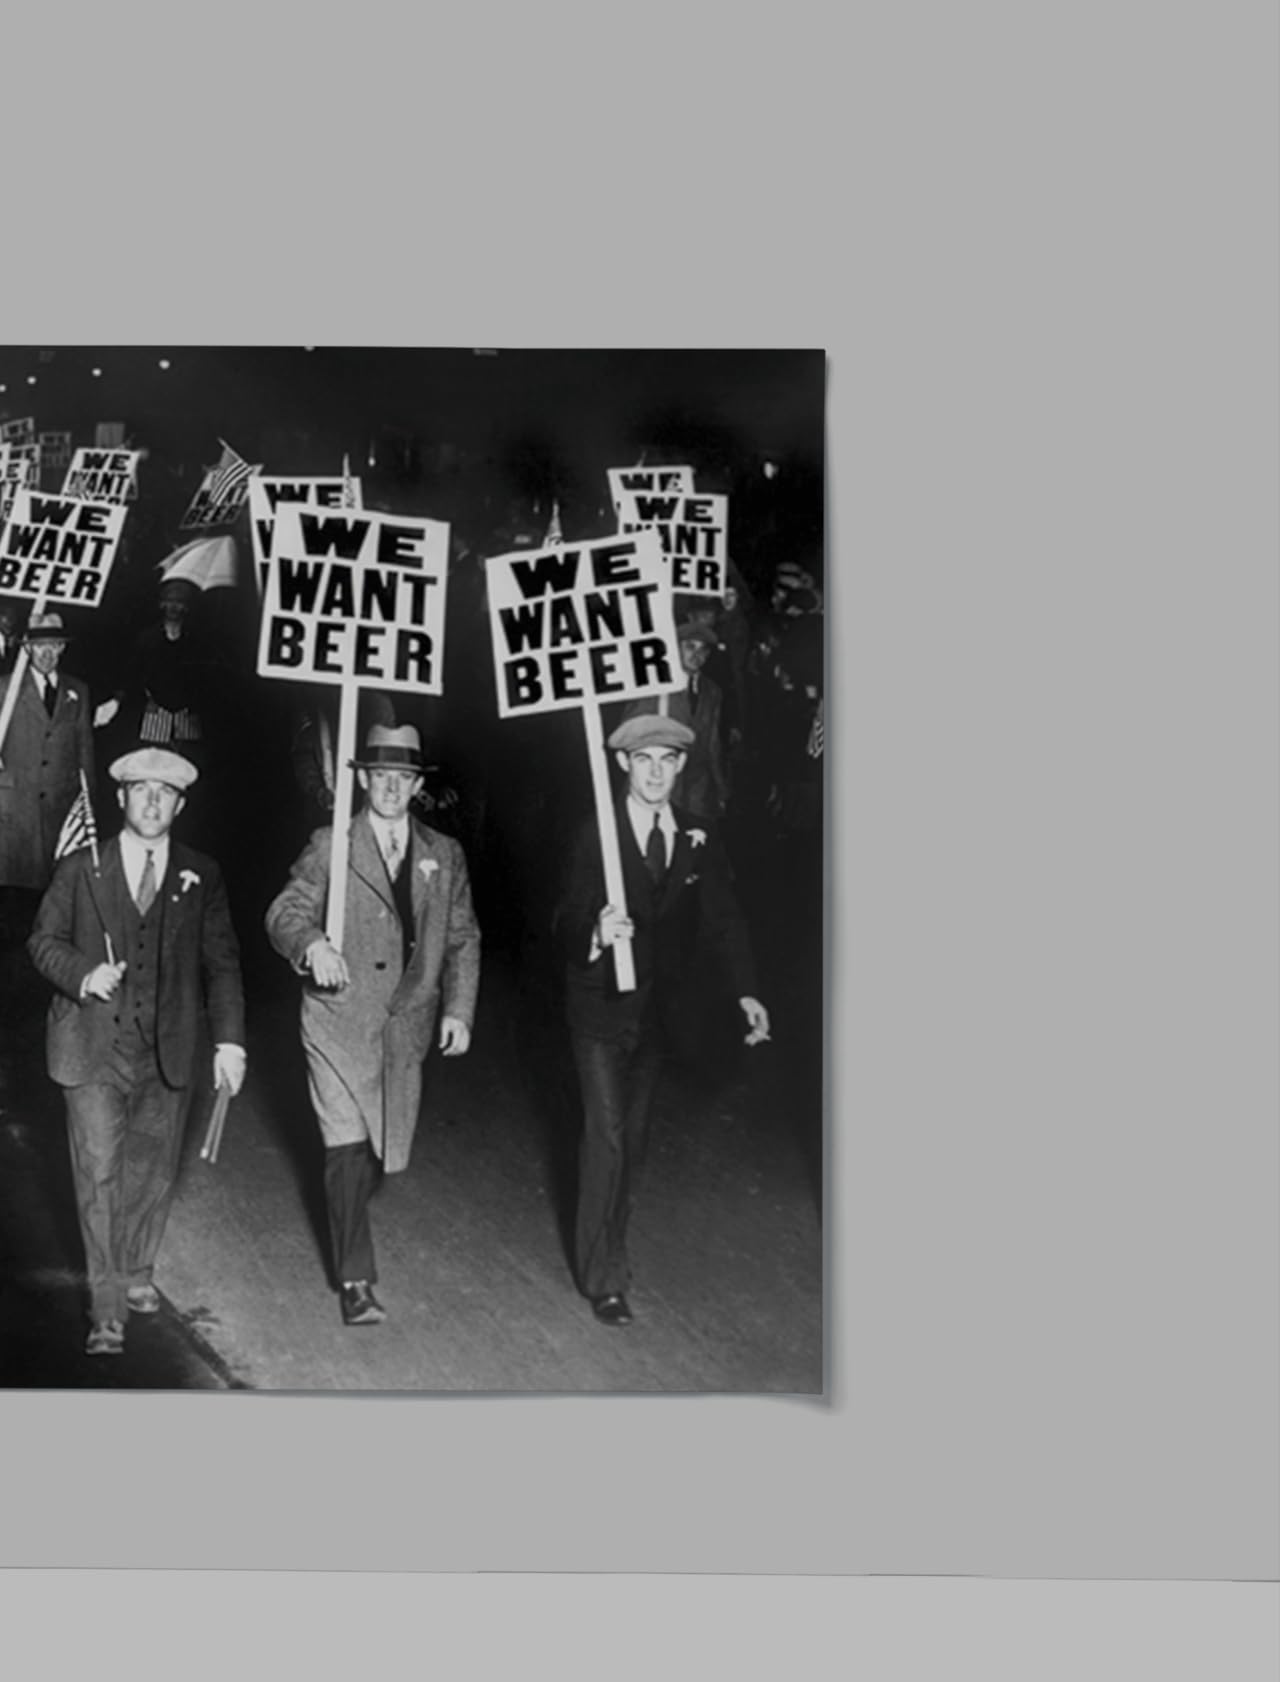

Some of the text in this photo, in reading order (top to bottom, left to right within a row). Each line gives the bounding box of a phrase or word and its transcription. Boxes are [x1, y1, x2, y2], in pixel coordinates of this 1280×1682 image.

[83, 452, 130, 471] WE
[29, 496, 112, 533] WE
[634, 496, 714, 524] WE
[7, 523, 114, 568] WANT
[299, 512, 426, 570] WE
[278, 557, 438, 626] WANT
[509, 542, 641, 600] WE
[498, 583, 659, 655] WANT
[267, 615, 433, 685] BEER
[504, 637, 673, 709] BEER
